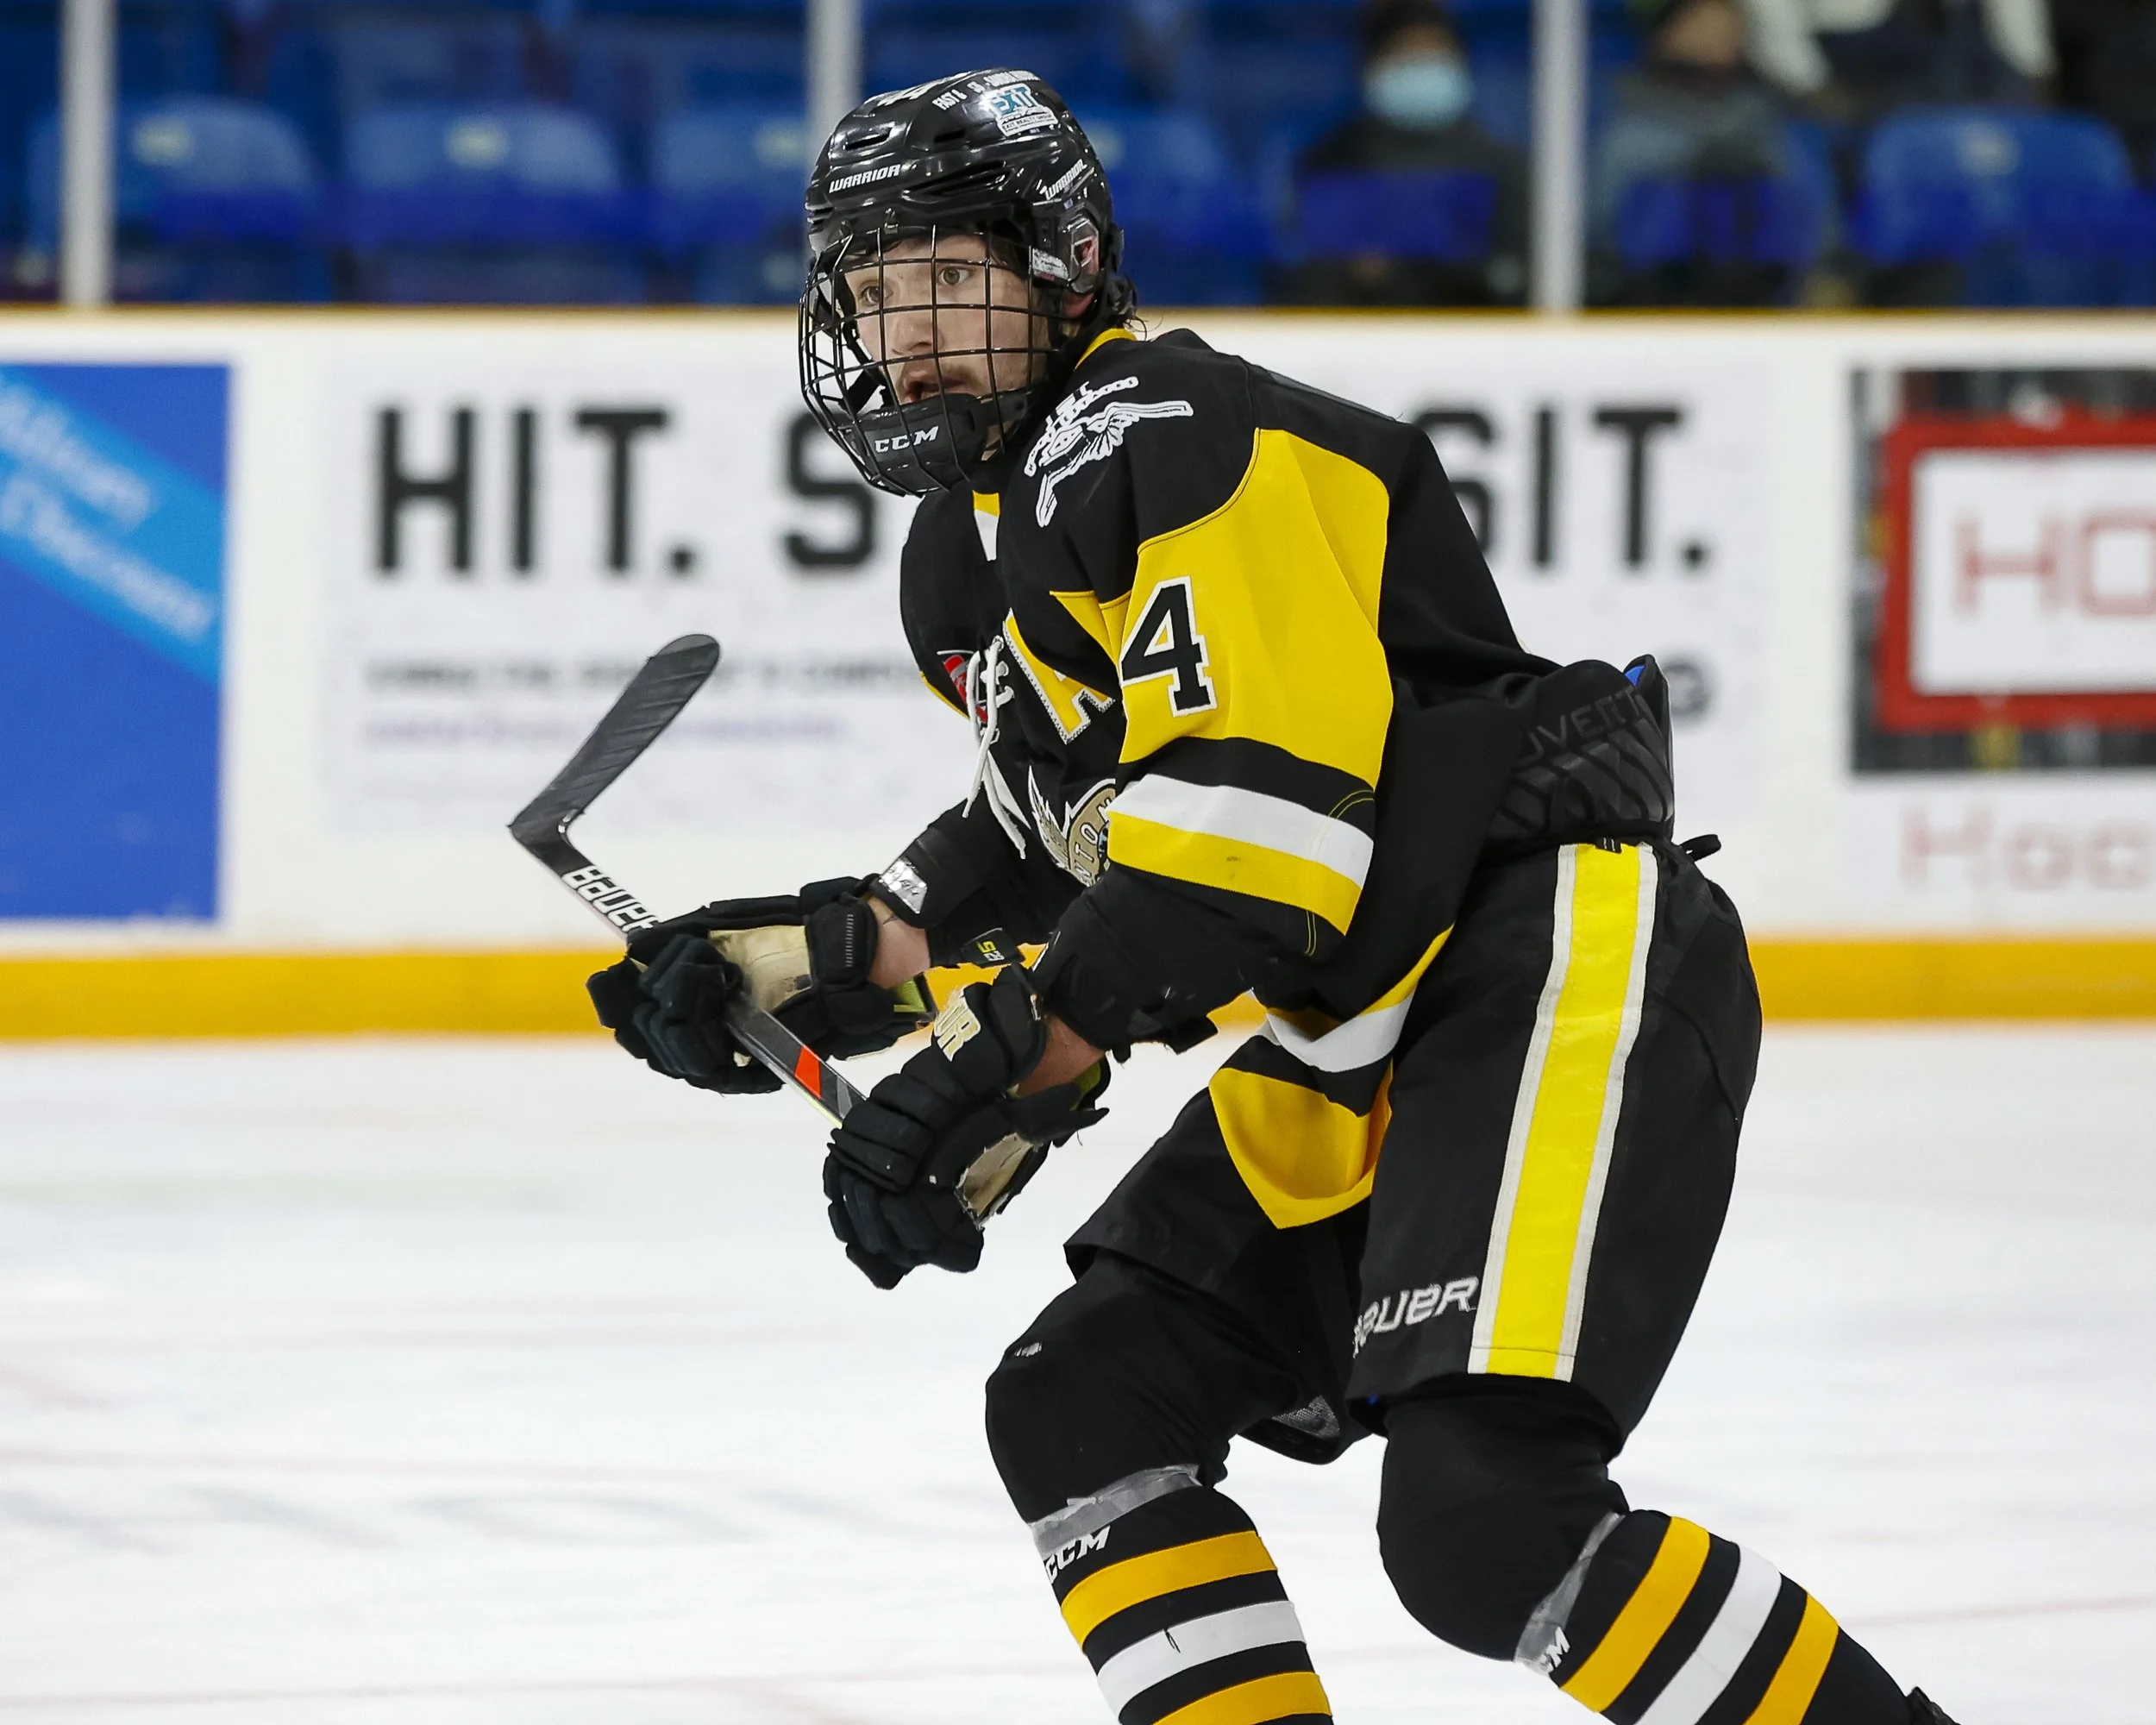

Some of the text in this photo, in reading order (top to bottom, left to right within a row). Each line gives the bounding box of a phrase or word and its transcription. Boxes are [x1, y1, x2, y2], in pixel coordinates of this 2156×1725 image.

[829, 164, 901, 194] WARRIOR
[1044, 159, 1087, 201] WARRIOR
[874, 425, 939, 453] CCM
[373, 405, 698, 574] HIT.
[1119, 575, 1218, 718] 4
[1045, 1524, 1112, 1584] CCM
